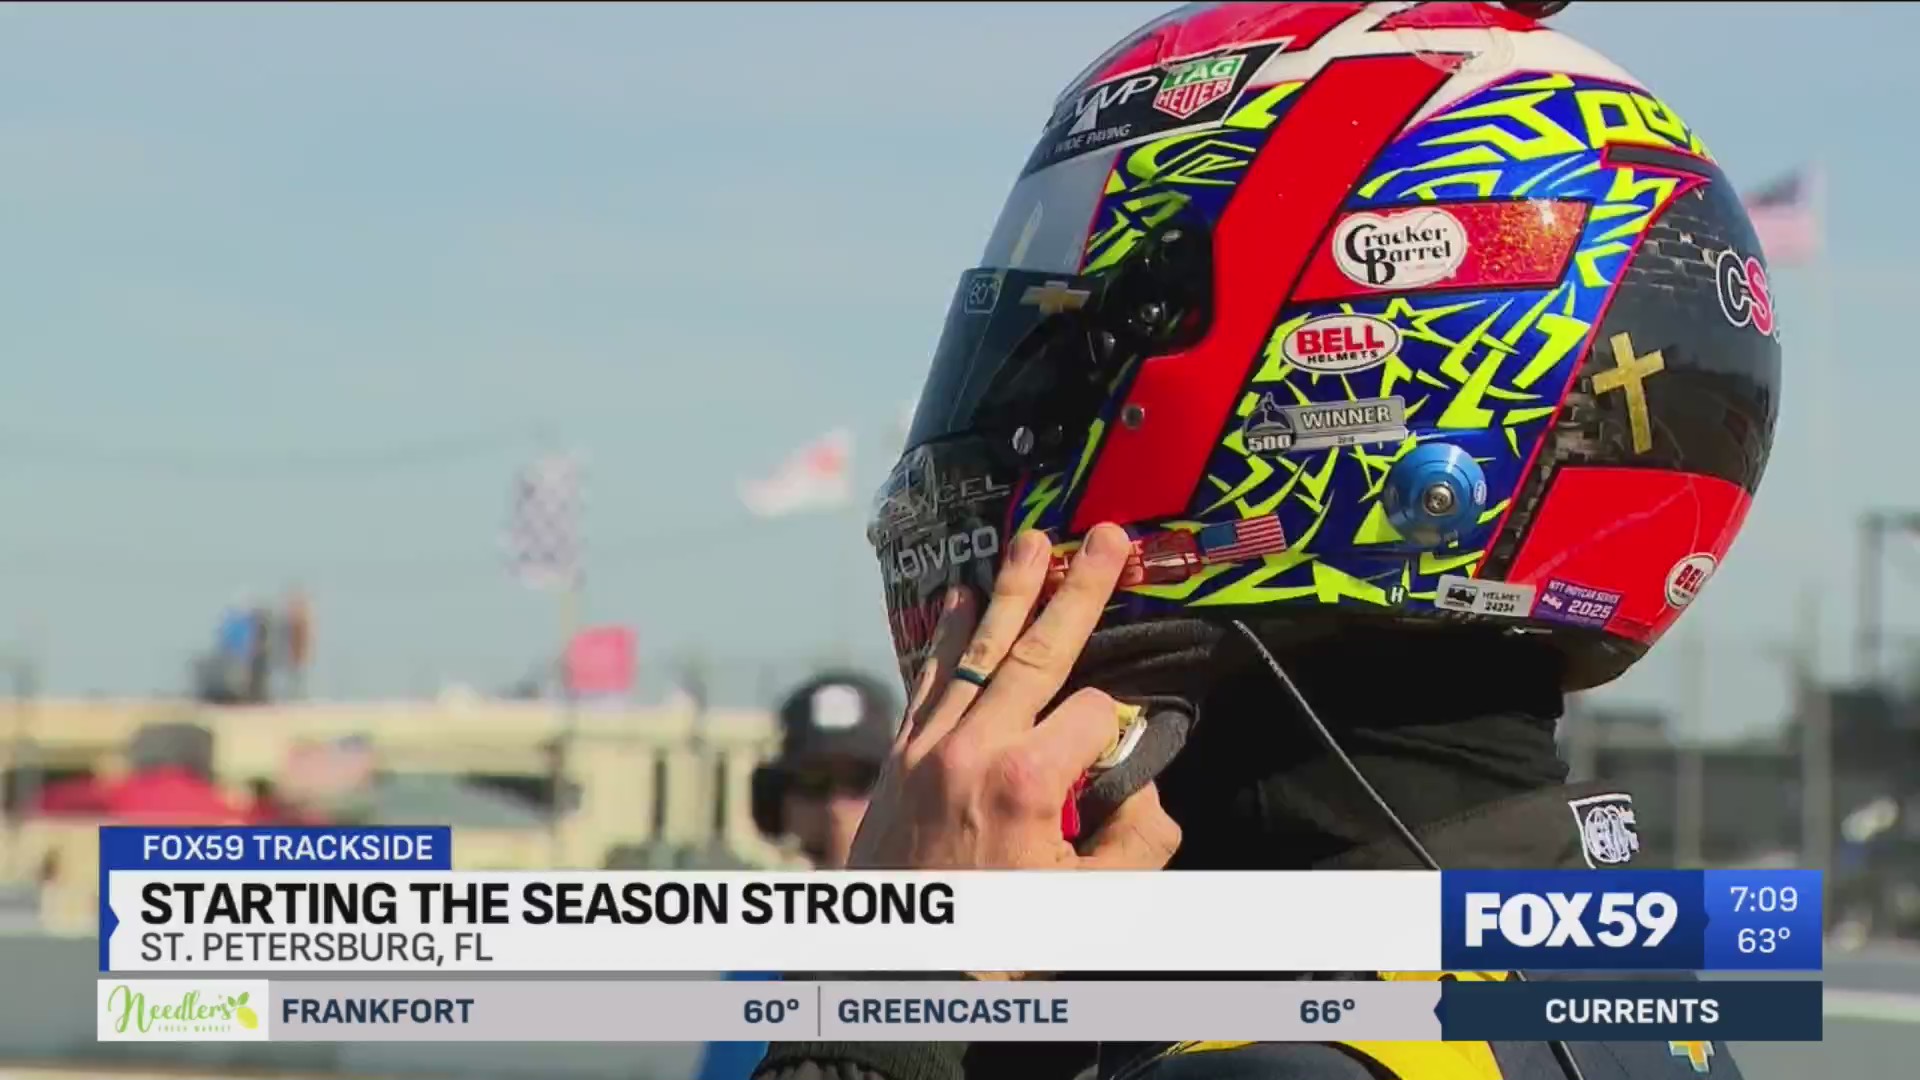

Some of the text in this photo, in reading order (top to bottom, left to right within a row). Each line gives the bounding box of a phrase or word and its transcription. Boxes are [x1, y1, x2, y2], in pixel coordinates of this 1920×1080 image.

[1170, 58, 1236, 85] TAG
[1158, 80, 1230, 113] HEUER
[1345, 223, 1448, 264] Cracker
[1366, 240, 1452, 285] Barrel
[1296, 325, 1385, 354] BELL
[1307, 350, 1379, 365] HELMETS
[1301, 402, 1392, 430] WINNER
[1247, 434, 1292, 452] 500
[1567, 599, 1613, 619] 2025
